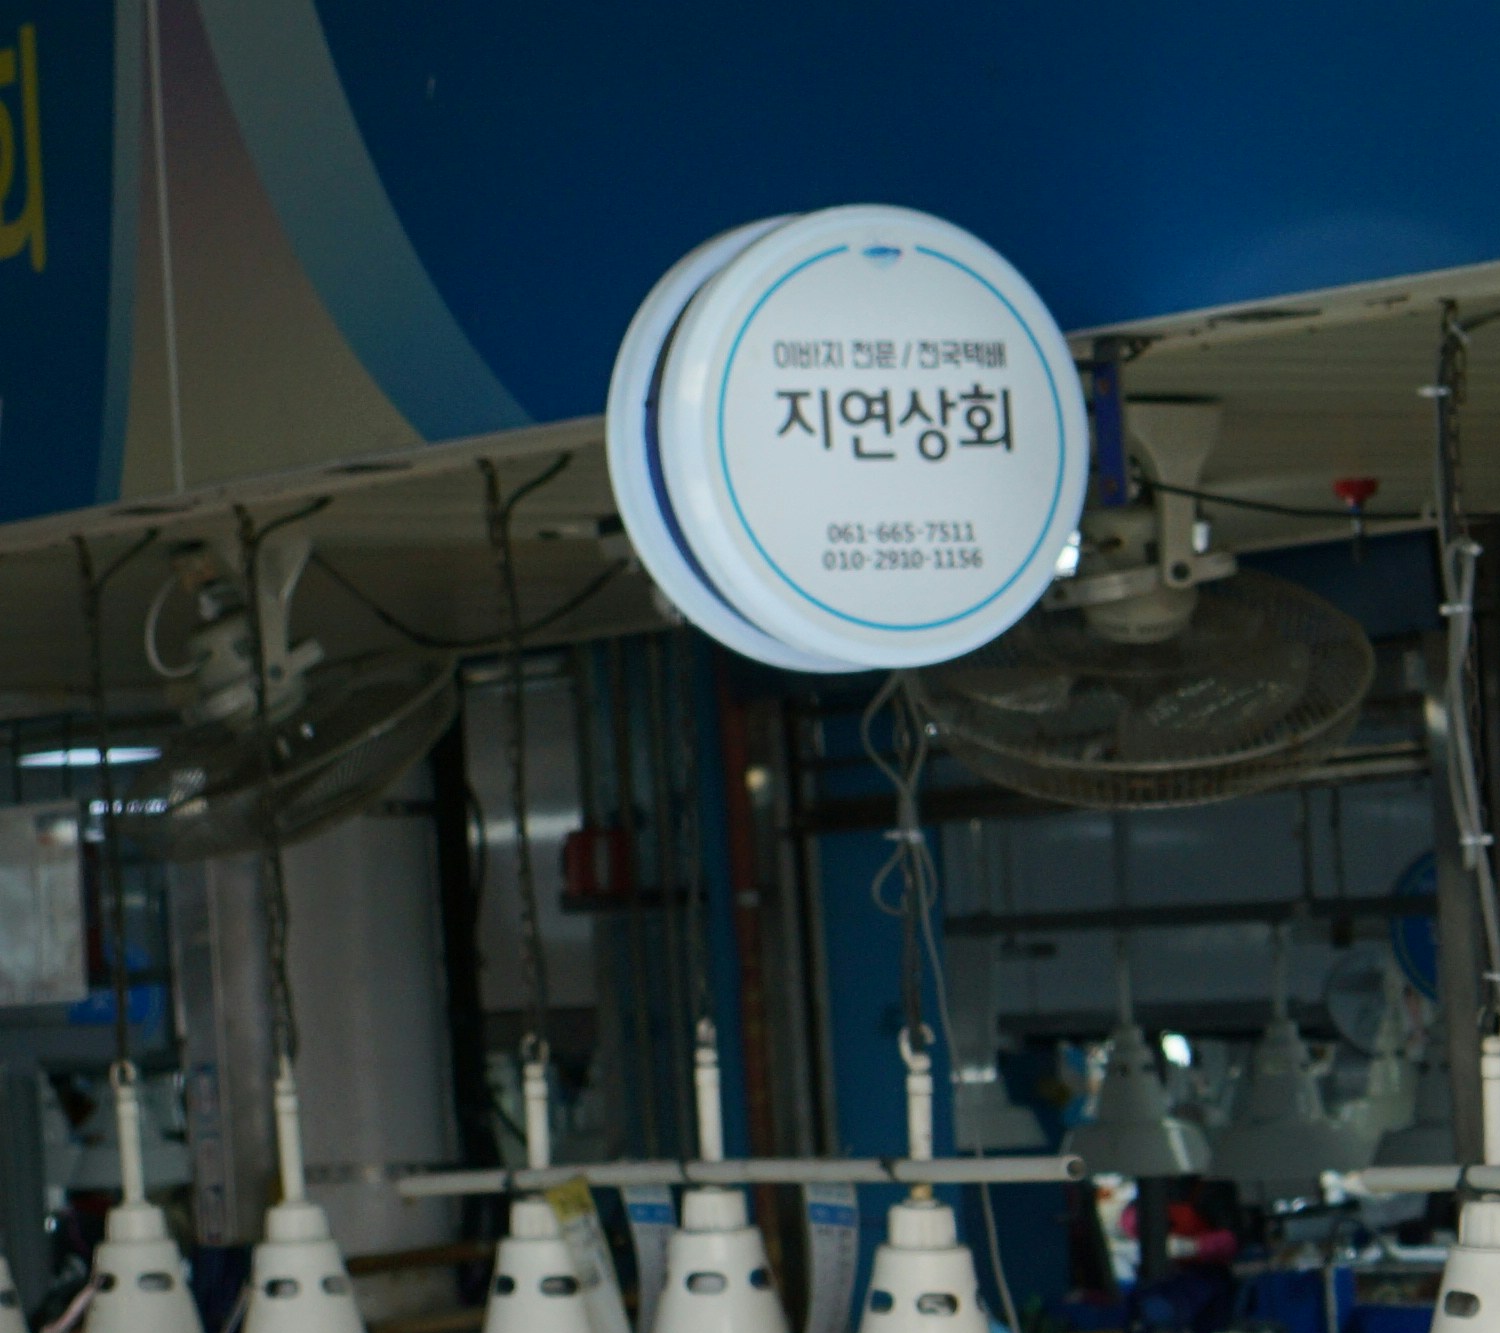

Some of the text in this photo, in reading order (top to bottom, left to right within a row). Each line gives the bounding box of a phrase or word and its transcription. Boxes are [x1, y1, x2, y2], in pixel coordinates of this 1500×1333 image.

[852, 340, 897, 369] 전문
[918, 340, 1007, 369] 전국택배
[776, 383, 1013, 462] 지연상회
[827, 521, 976, 543] 061-665-7511
[822, 548, 984, 571] 010-2910-1156
